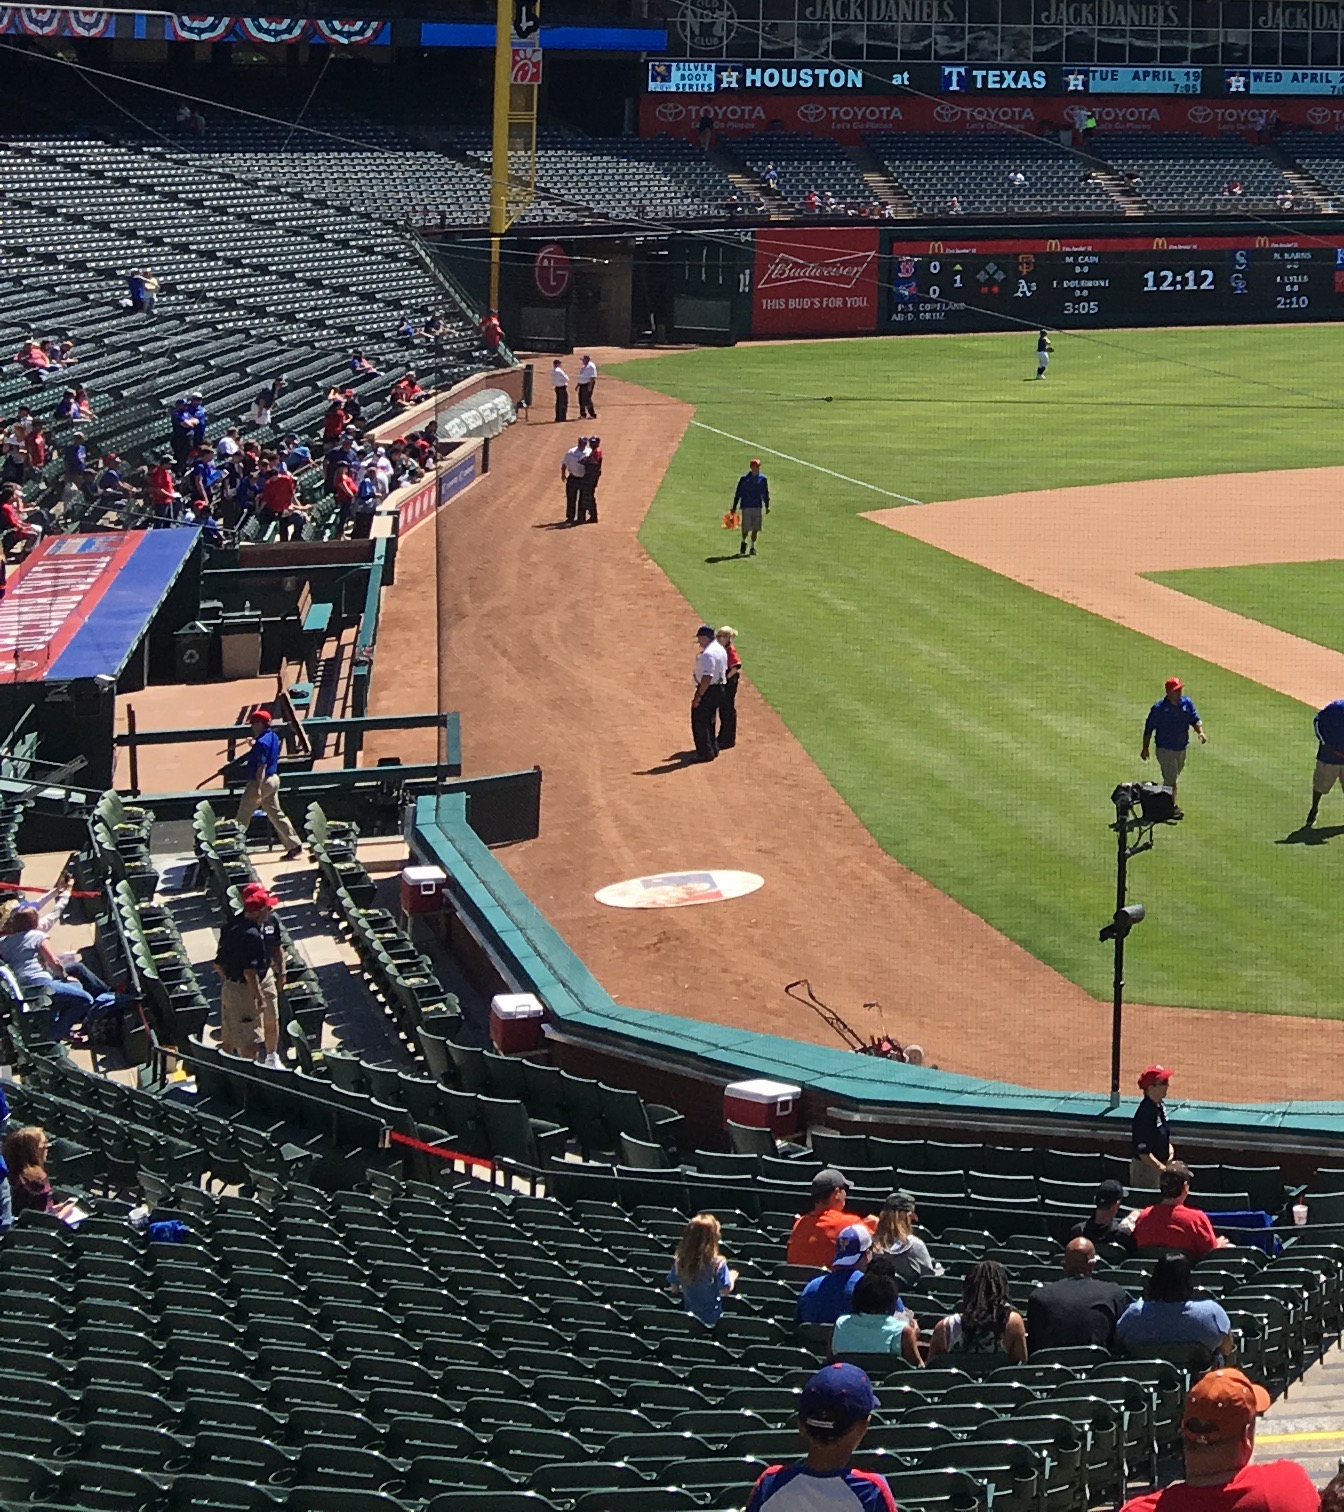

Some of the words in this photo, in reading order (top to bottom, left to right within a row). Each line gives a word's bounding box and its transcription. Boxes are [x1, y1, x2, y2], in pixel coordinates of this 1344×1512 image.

[1258, 1, 1310, 29] JACK
[675, 64, 714, 73] SILVER
[680, 73, 708, 82] BOOT
[746, 68, 863, 88] HOUSTON
[892, 71, 910, 86] at
[972, 70, 1047, 89] TEXAS
[1090, 70, 1119, 83] TUE
[1131, 70, 1175, 83] APRIL
[1184, 70, 1200, 83] 19
[1252, 71, 1283, 84] WED
[1290, 72, 1333, 85] APRIL
[675, 83, 713, 92] SERIES
[1173, 84, 1199, 94] 7:05
[688, 105, 766, 120] TOYOTA
[828, 106, 903, 120] TOYOTA
[965, 107, 1035, 121] TOYOTA
[1092, 108, 1160, 121] TOYOTA
[1078, 256, 1099, 264] CAIN
[767, 263, 866, 279] Budweiser
[930, 261, 941, 274] 0
[953, 274, 963, 288] 1
[1143, 269, 1215, 291] 12:12
[929, 285, 940, 299] 0
[761, 298, 786, 310] THIS
[788, 297, 820, 309] BUD'S
[822, 297, 843, 308] FOR
[845, 296, 870, 308] YOU.
[1063, 301, 1099, 315] 3:05
[1276, 296, 1309, 309] 2:10
